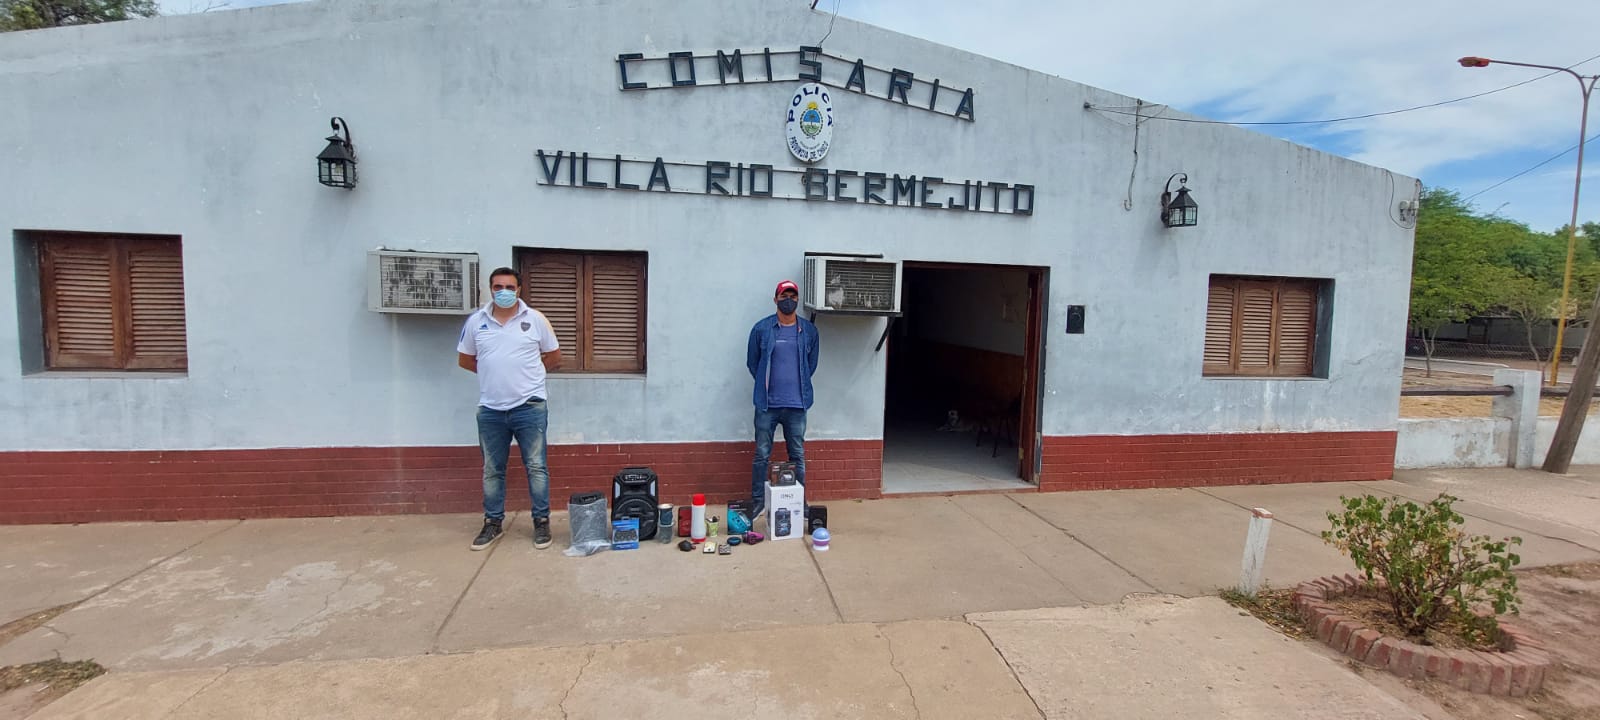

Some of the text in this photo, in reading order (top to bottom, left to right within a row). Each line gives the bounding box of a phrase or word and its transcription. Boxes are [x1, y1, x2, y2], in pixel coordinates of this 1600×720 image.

[618, 45, 975, 122] COMISARIA
[787, 86, 833, 127] POLICIA
[537, 149, 1035, 216] VILLA RIO BERMEJITO
